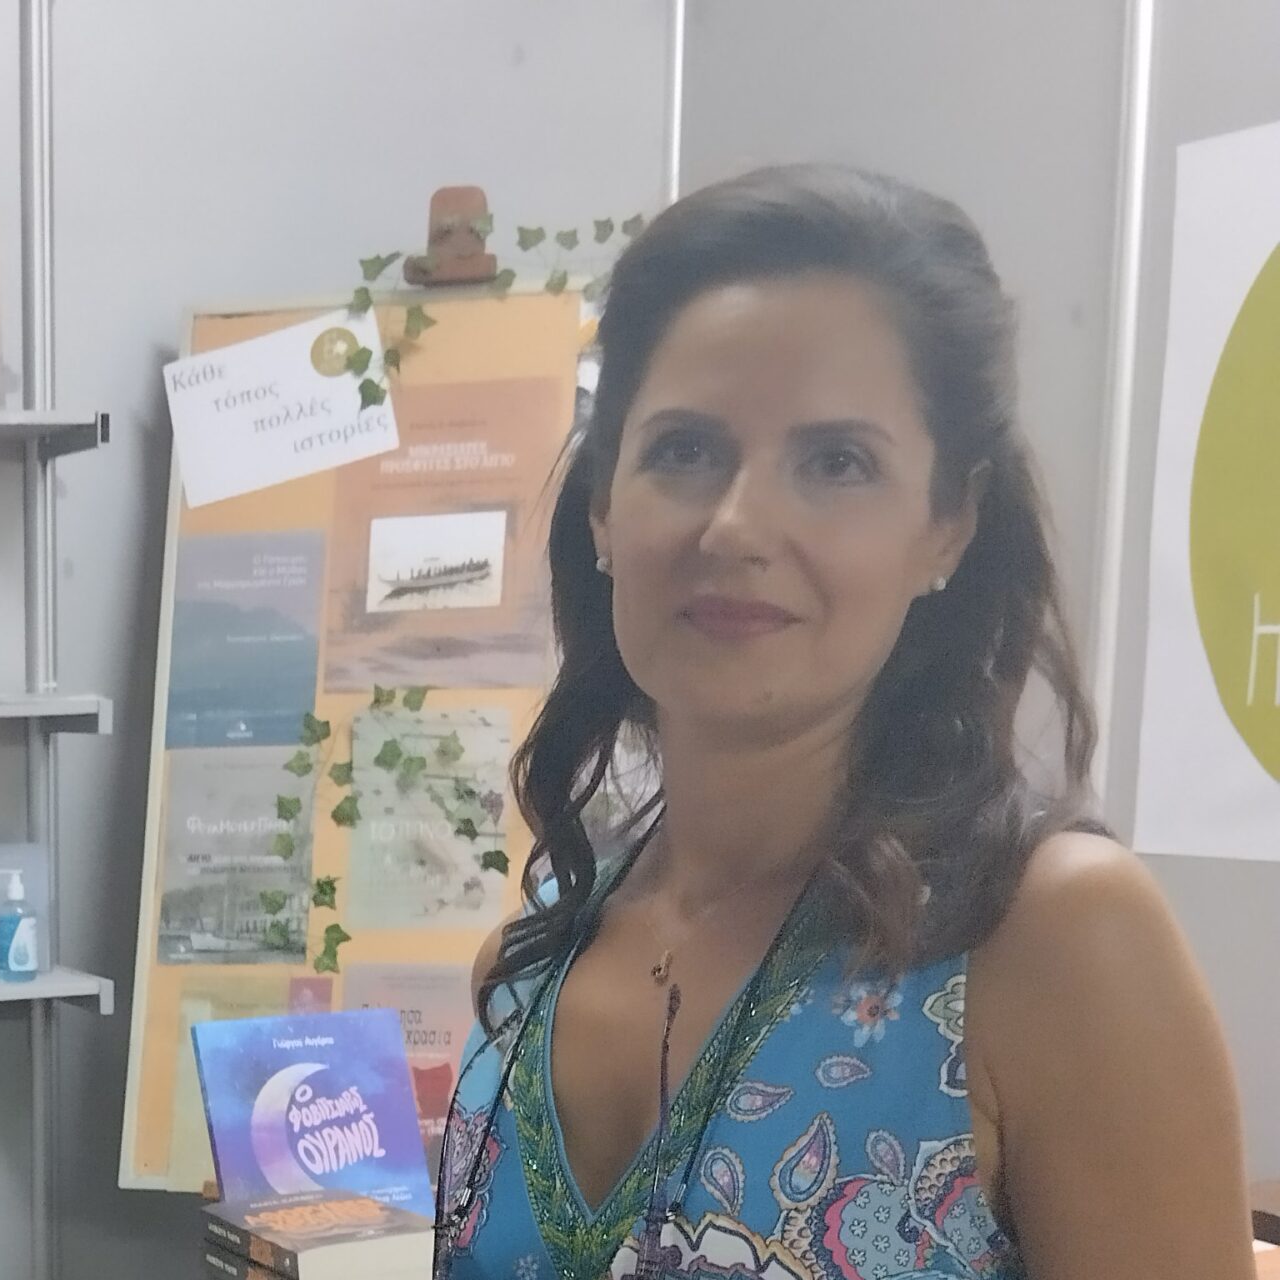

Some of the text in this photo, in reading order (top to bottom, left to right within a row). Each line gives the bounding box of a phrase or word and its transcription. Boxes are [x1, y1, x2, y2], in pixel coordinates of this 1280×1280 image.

[171, 363, 226, 393] Κάθε
[214, 381, 280, 412] τόπος
[253, 396, 333, 434] πολλές
[293, 412, 389, 454] ιστορίες
